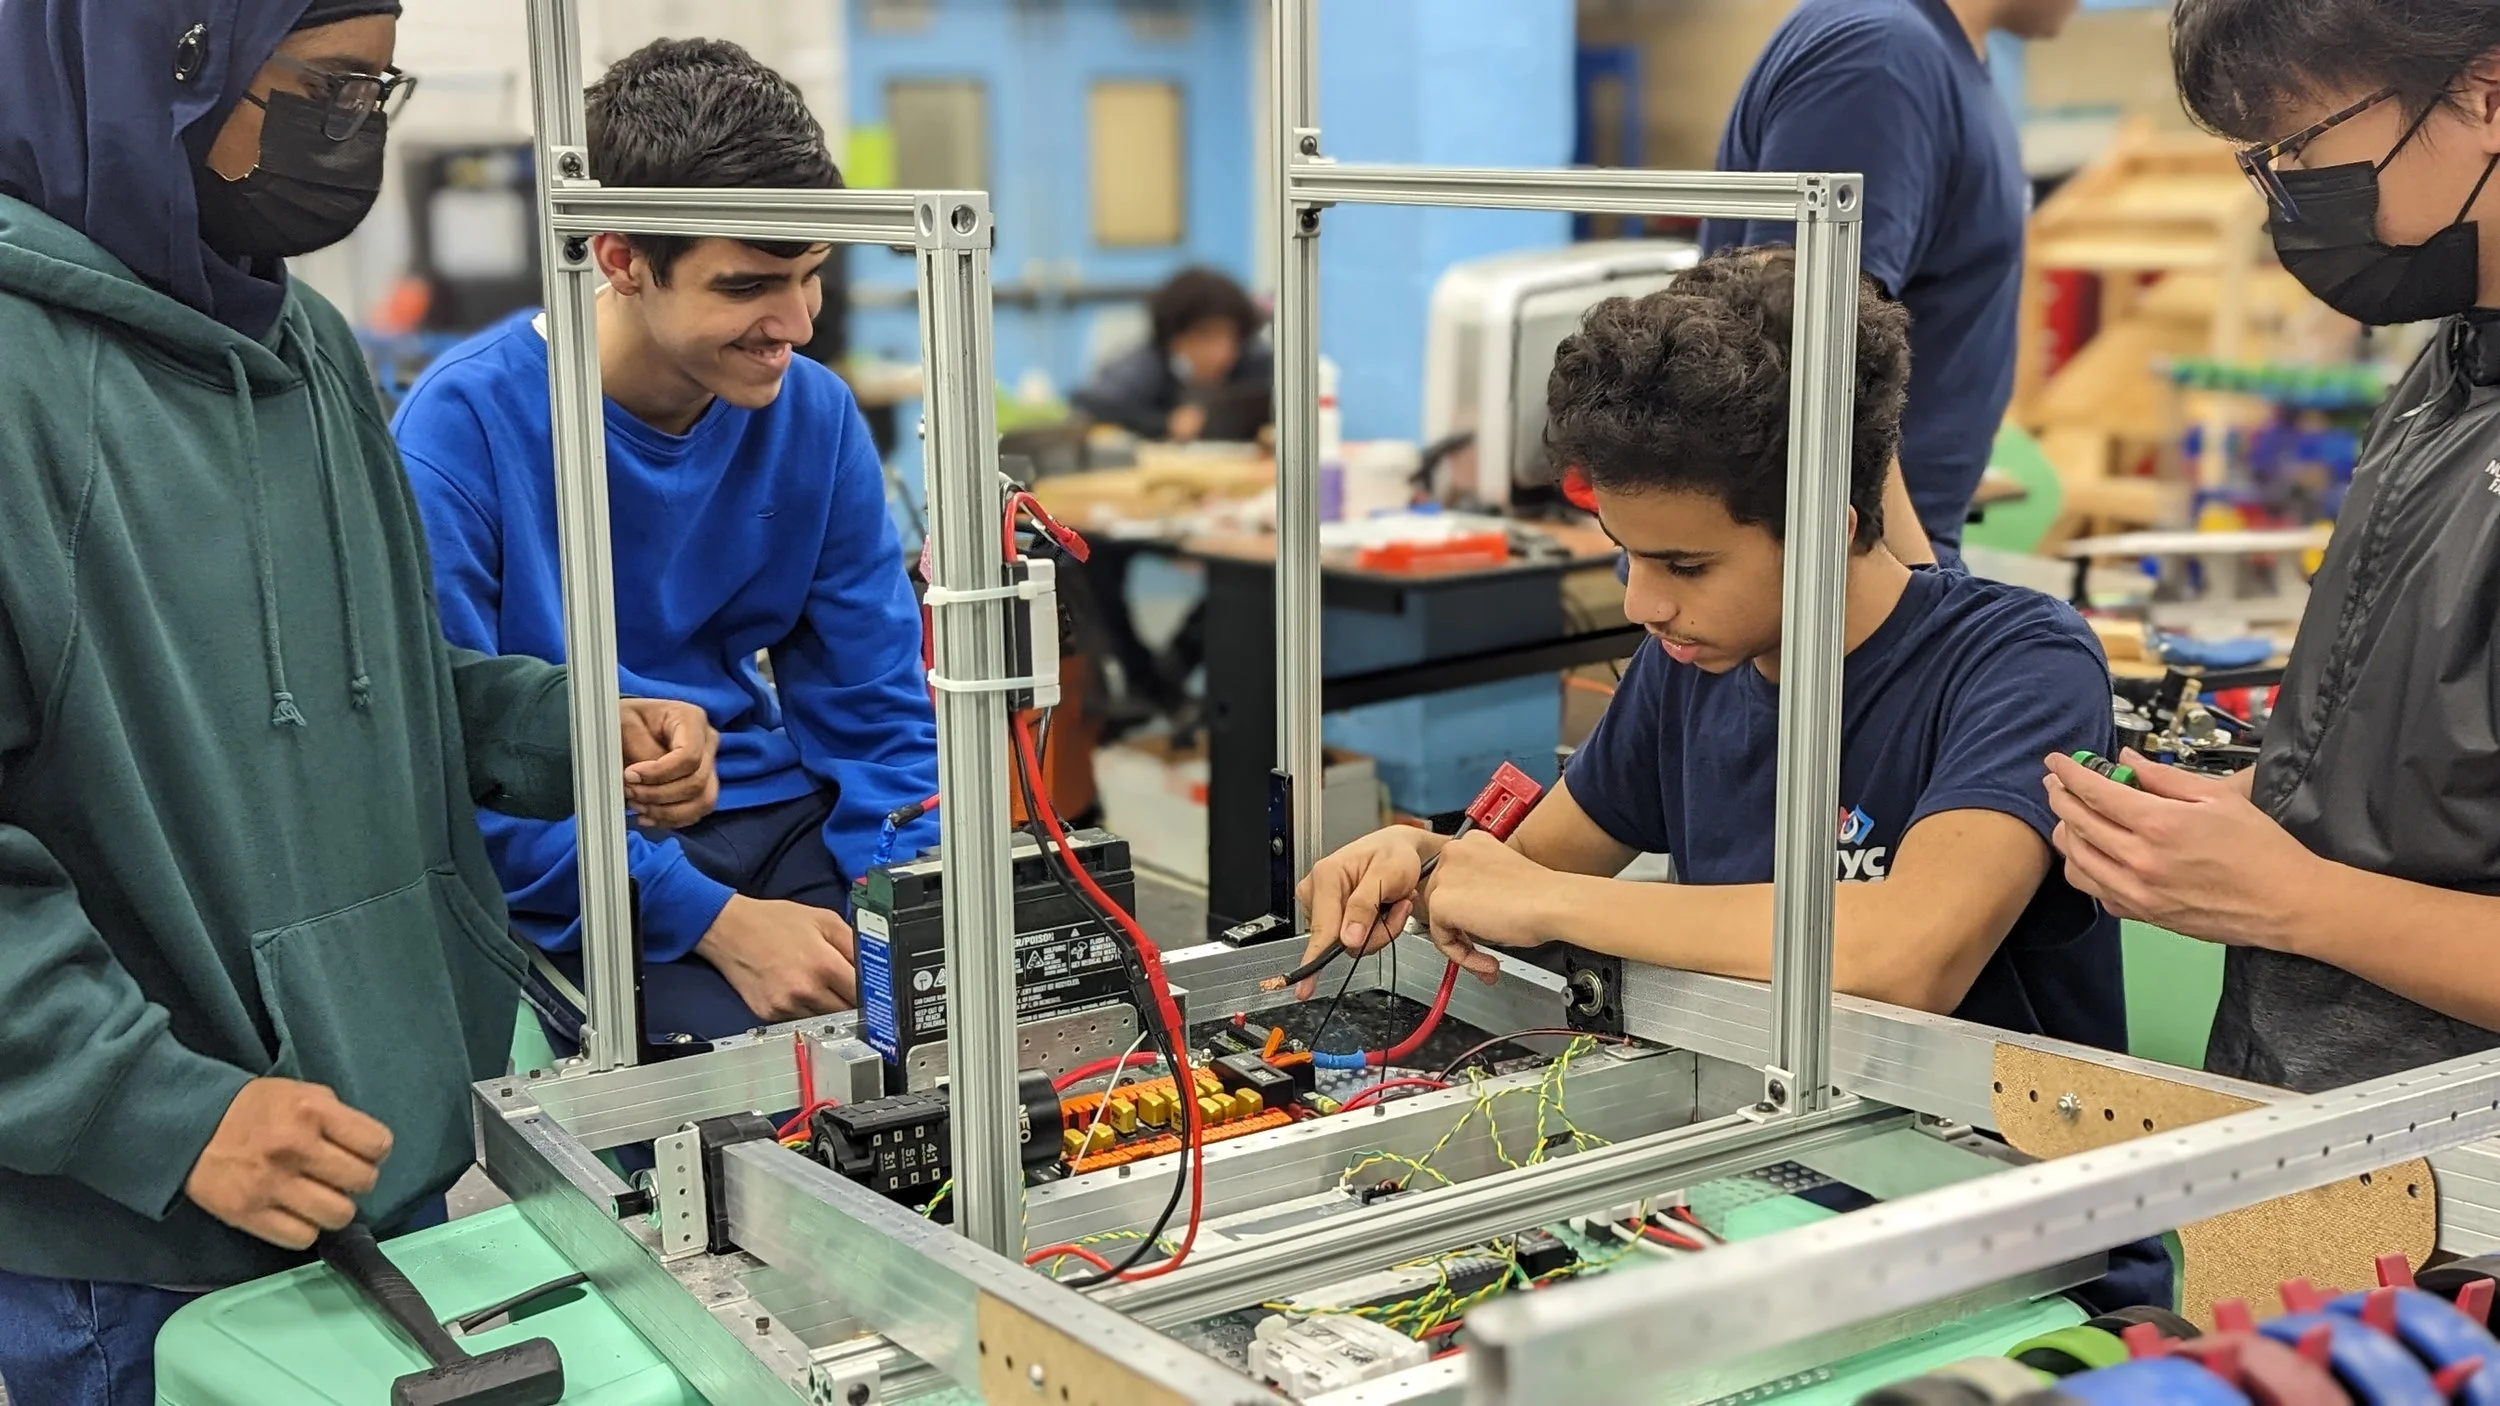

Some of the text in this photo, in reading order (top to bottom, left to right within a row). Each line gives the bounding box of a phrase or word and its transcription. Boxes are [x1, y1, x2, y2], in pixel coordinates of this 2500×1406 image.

[1835, 846, 1886, 878] YC
[1019, 1104, 1031, 1143] NEO
[884, 1151, 896, 1170] 3:1
[905, 1148, 916, 1167] 5:1
[926, 1143, 938, 1163] 4:1
